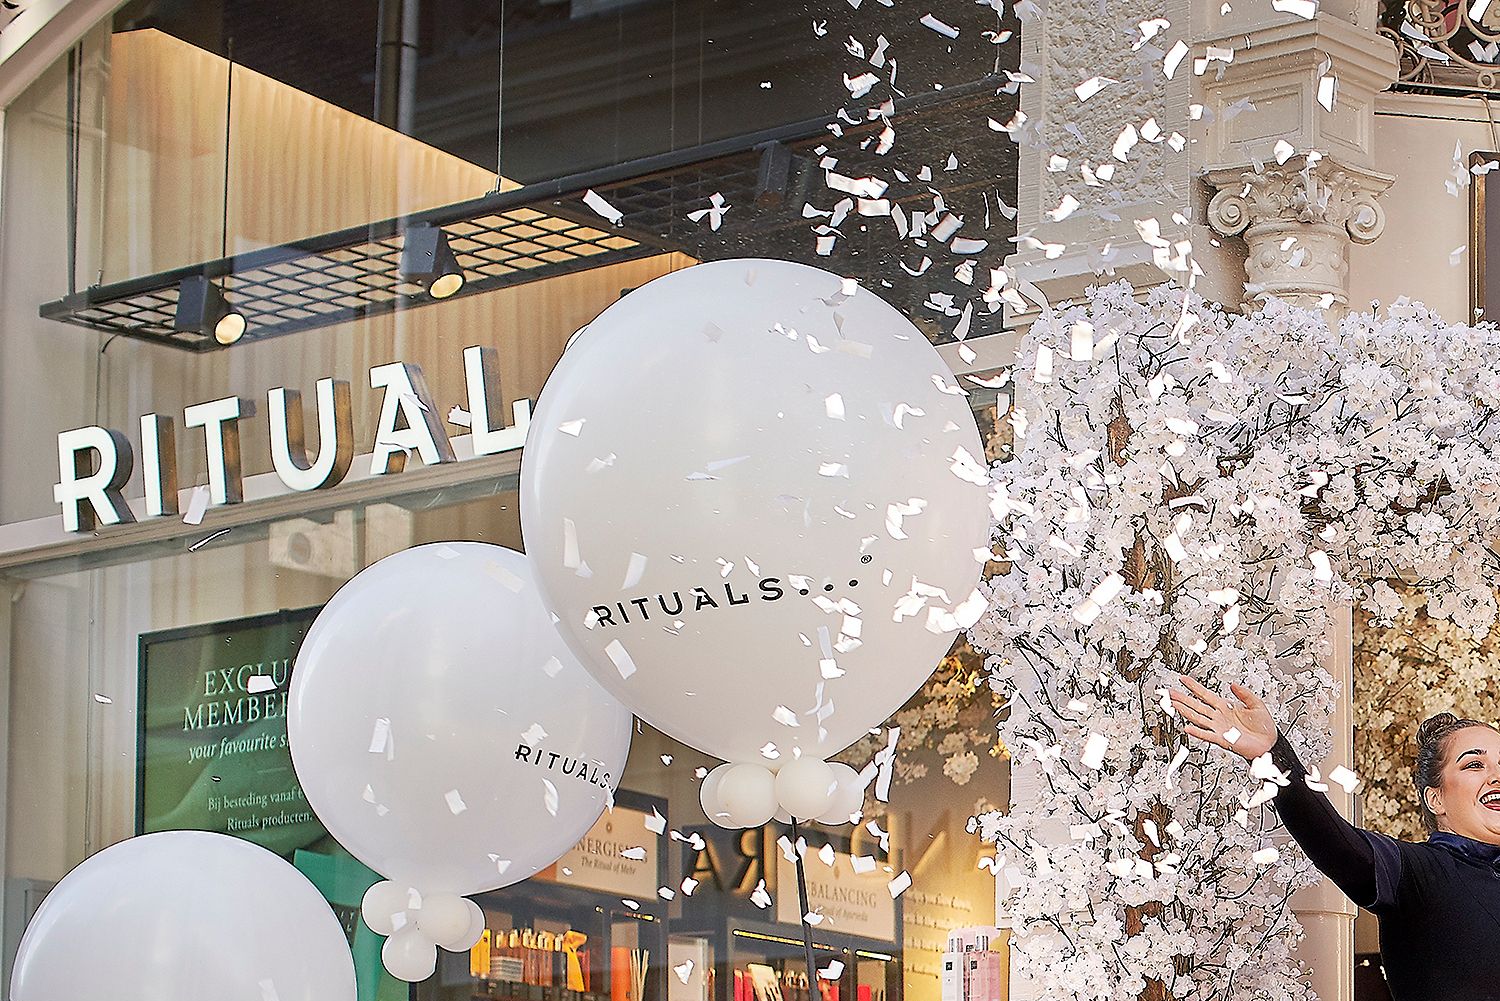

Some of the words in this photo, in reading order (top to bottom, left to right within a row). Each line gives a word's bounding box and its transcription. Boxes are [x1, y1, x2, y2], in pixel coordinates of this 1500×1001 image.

[53, 345, 531, 534] RITUAL
[204, 659, 295, 696] EXCU
[188, 743, 217, 764] your
[219, 732, 276, 759] favourite
[208, 797, 221, 812] Bij
[223, 792, 268, 809] besteding
[270, 785, 297, 803] vanaf
[227, 814, 259, 831] Rituals
[262, 810, 313, 830] producten.
[806, 881, 877, 909] BALANCING
